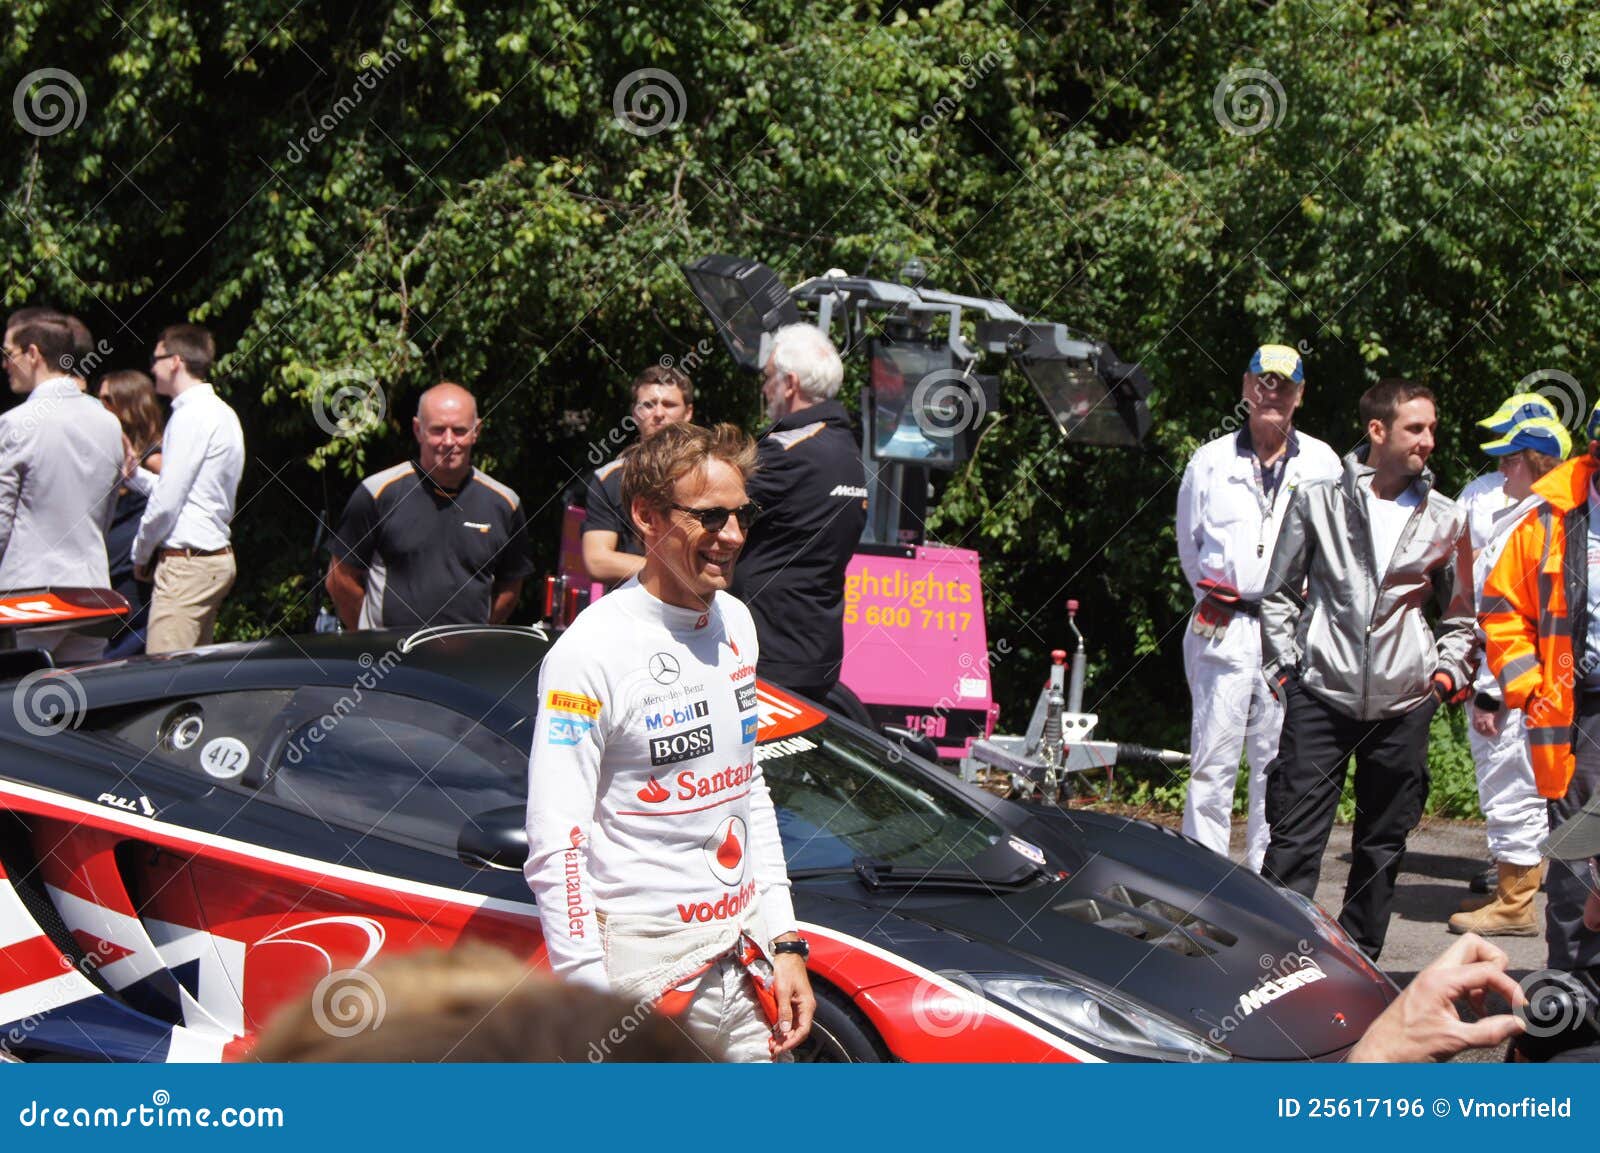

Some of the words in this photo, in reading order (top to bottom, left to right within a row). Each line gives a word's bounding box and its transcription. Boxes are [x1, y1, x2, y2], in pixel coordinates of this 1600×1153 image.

[844, 566, 973, 608] ghtlights
[845, 604, 859, 624] 5
[865, 605, 911, 628] 600
[921, 609, 973, 632] 7117
[550, 721, 587, 742] SAP
[645, 704, 694, 731] Mobil
[653, 728, 711, 758] BOSS
[208, 745, 242, 771] 412
[677, 760, 752, 801] Santan
[97, 792, 137, 811] PULL
[565, 849, 590, 938] antander
[1239, 967, 1328, 1016] McLaren
